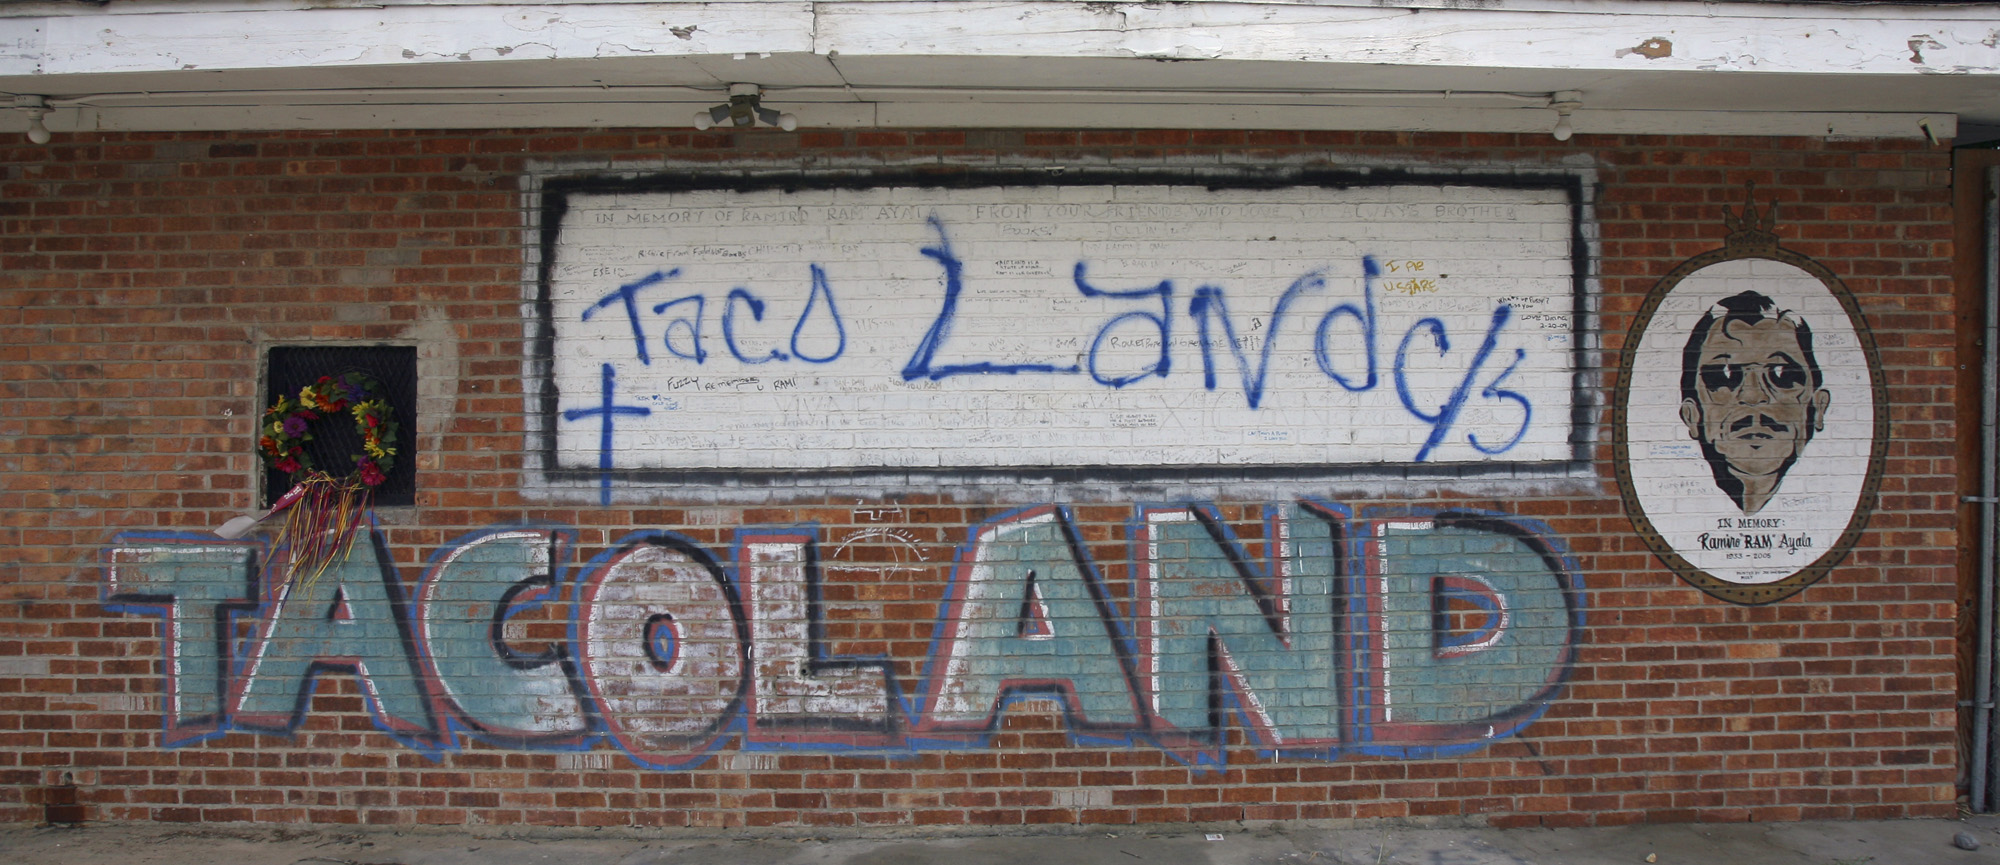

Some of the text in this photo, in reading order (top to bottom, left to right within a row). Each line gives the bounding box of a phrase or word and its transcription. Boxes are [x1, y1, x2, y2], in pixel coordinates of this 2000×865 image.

[595, 213, 614, 224] IN
[627, 210, 705, 224] MEMORY
[715, 210, 734, 221] OF
[976, 205, 1031, 220] FROM
[1194, 205, 1232, 218] WHO
[582, 263, 847, 366] Taco
[1717, 518, 1785, 529] IN MEMORY:
[1697, 532, 1812, 555] Ramiro "RAM" Ayala
[102, 498, 1586, 768] TACOLAND
